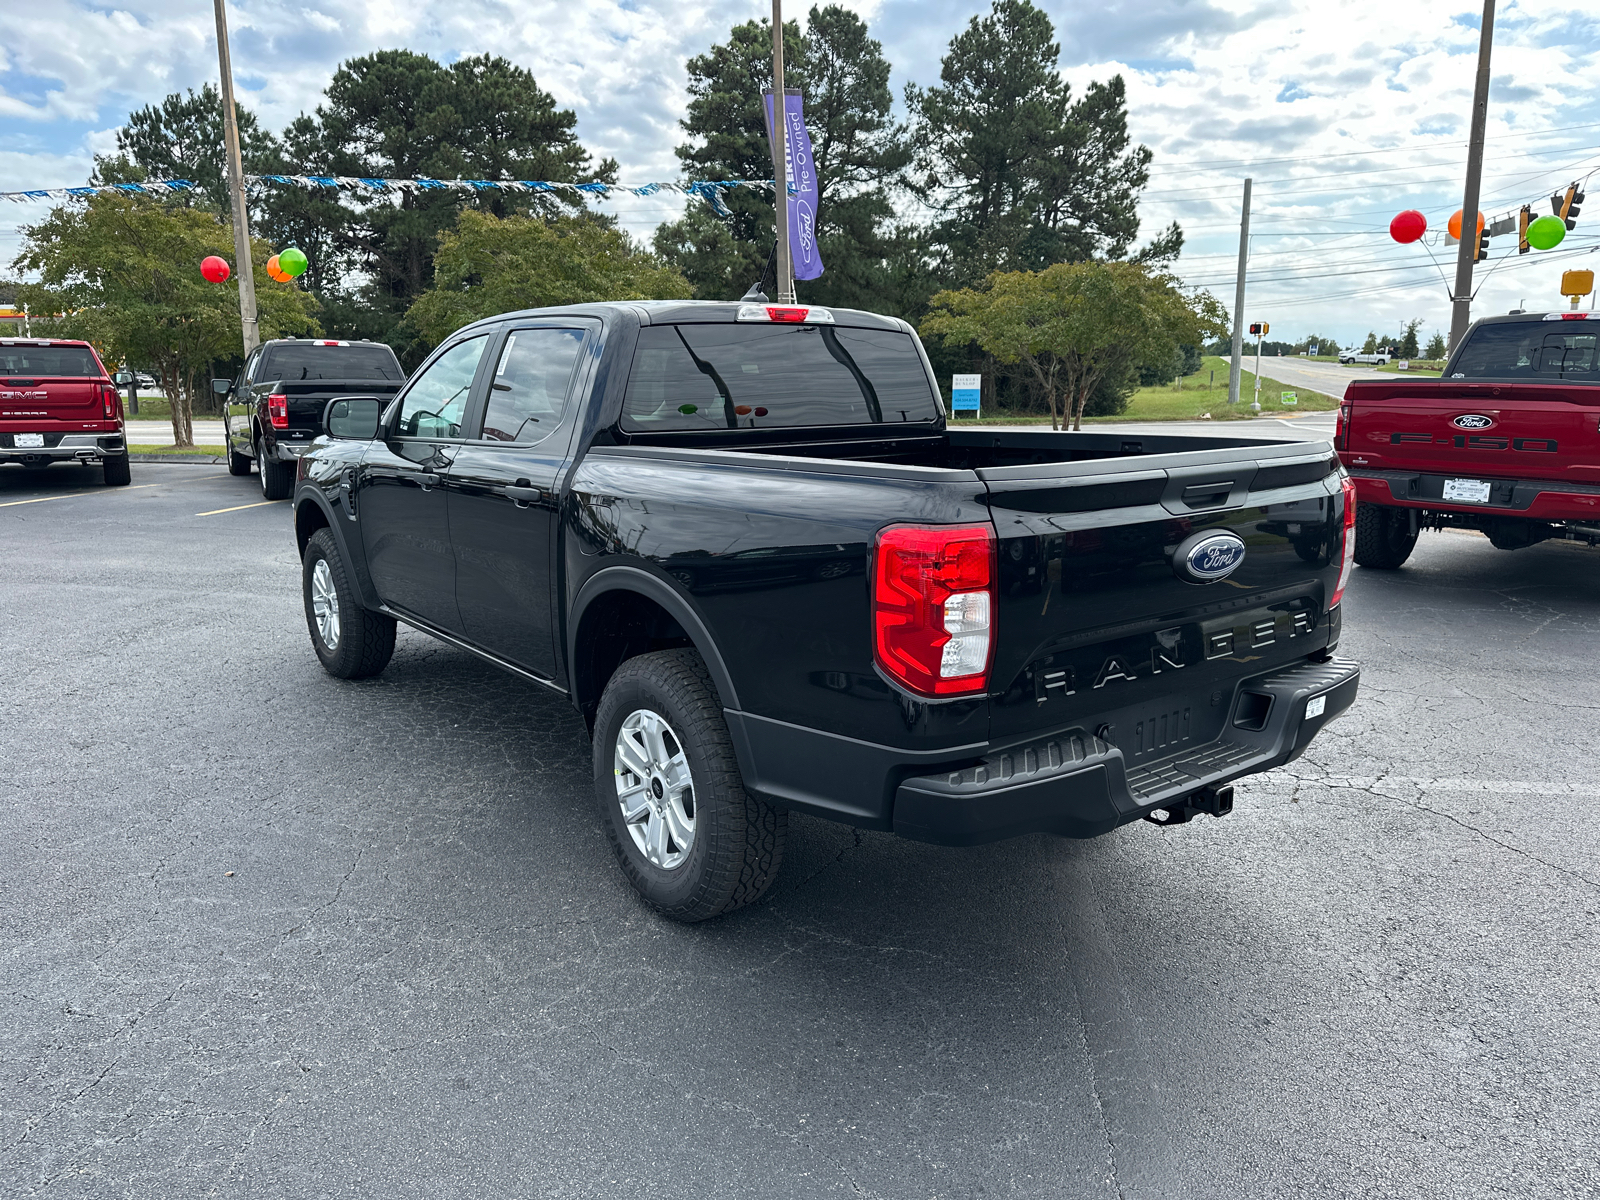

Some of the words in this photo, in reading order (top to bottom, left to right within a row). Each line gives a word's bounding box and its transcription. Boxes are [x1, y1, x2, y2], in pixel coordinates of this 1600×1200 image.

[788, 112, 812, 193] Pre-Owned
[800, 212, 812, 251] Ford
[0, 391, 48, 399] GMC
[1390, 432, 1559, 453] F-150
[1203, 545, 1235, 568] Ford
[1036, 608, 1315, 704] RANGER
